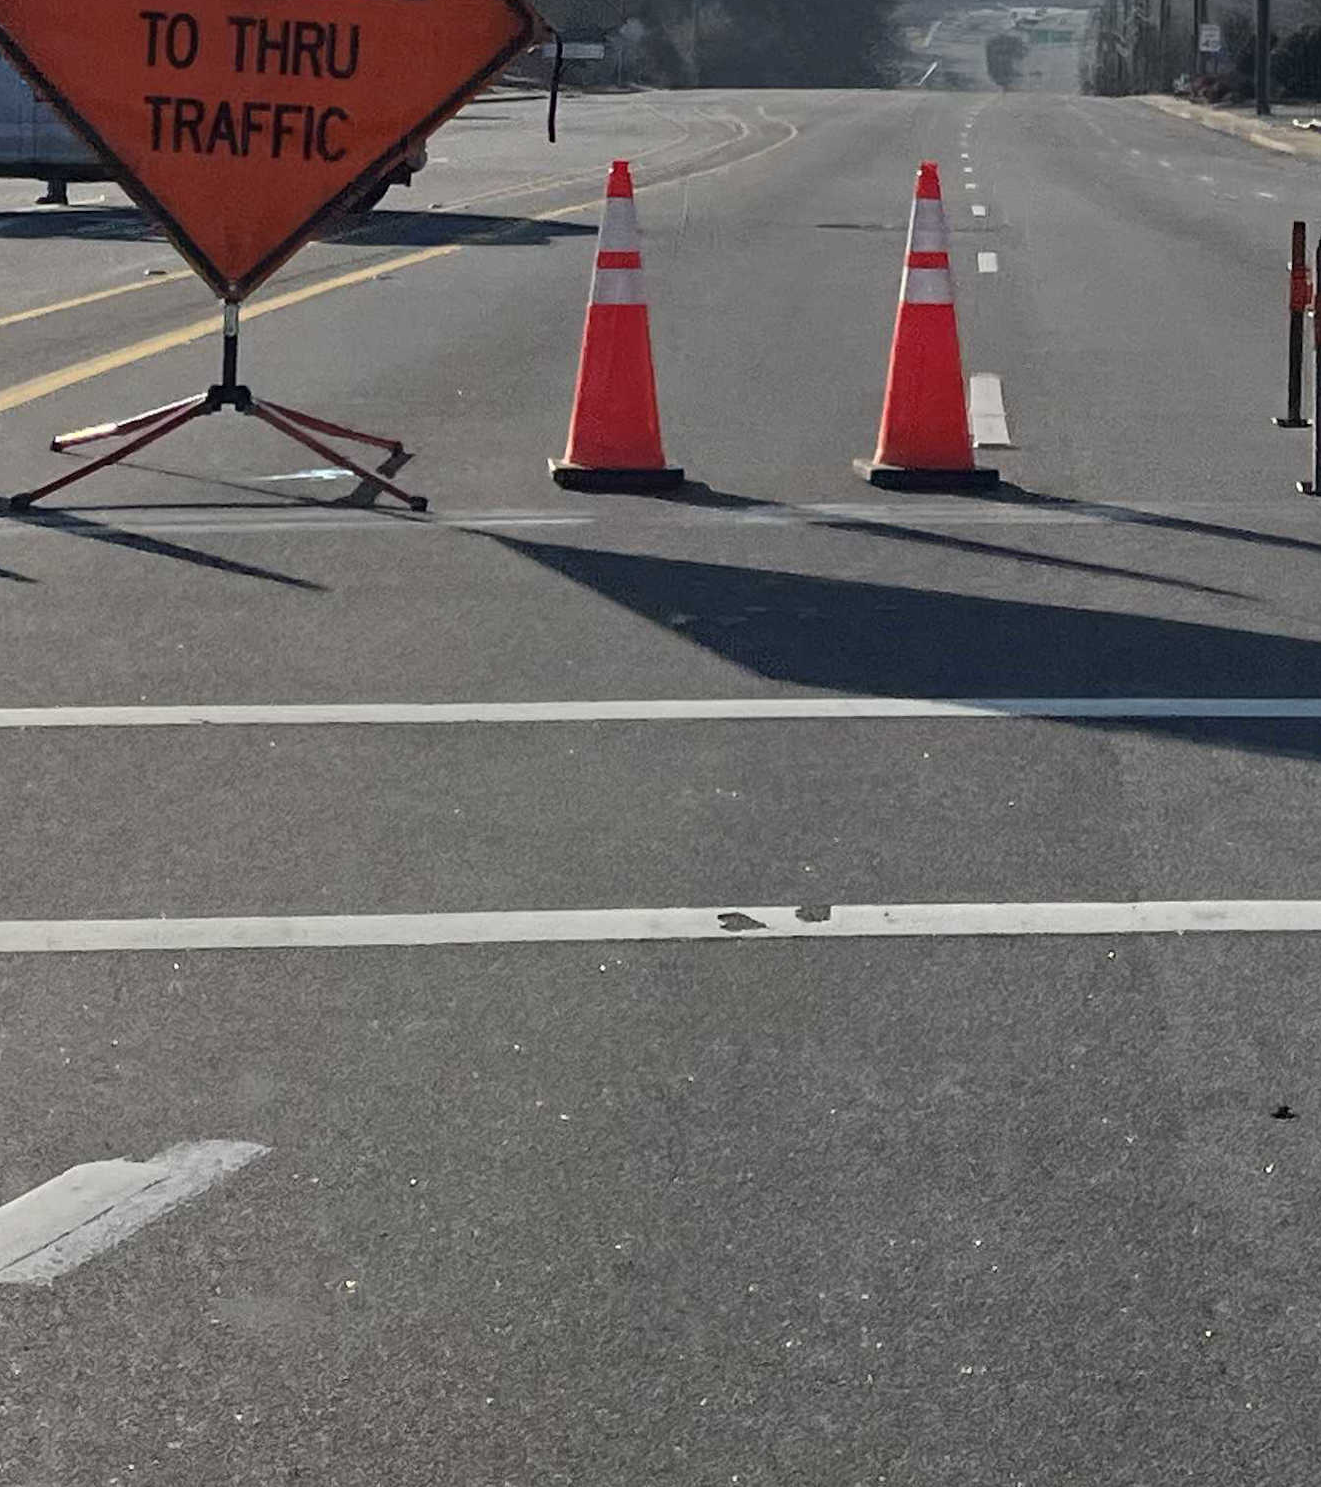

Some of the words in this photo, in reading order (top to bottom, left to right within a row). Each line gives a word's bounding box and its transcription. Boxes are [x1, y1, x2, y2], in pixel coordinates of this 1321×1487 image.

[138, 11, 199, 70] TO
[228, 16, 361, 79] THRU
[144, 96, 349, 163] TRAFFIC
